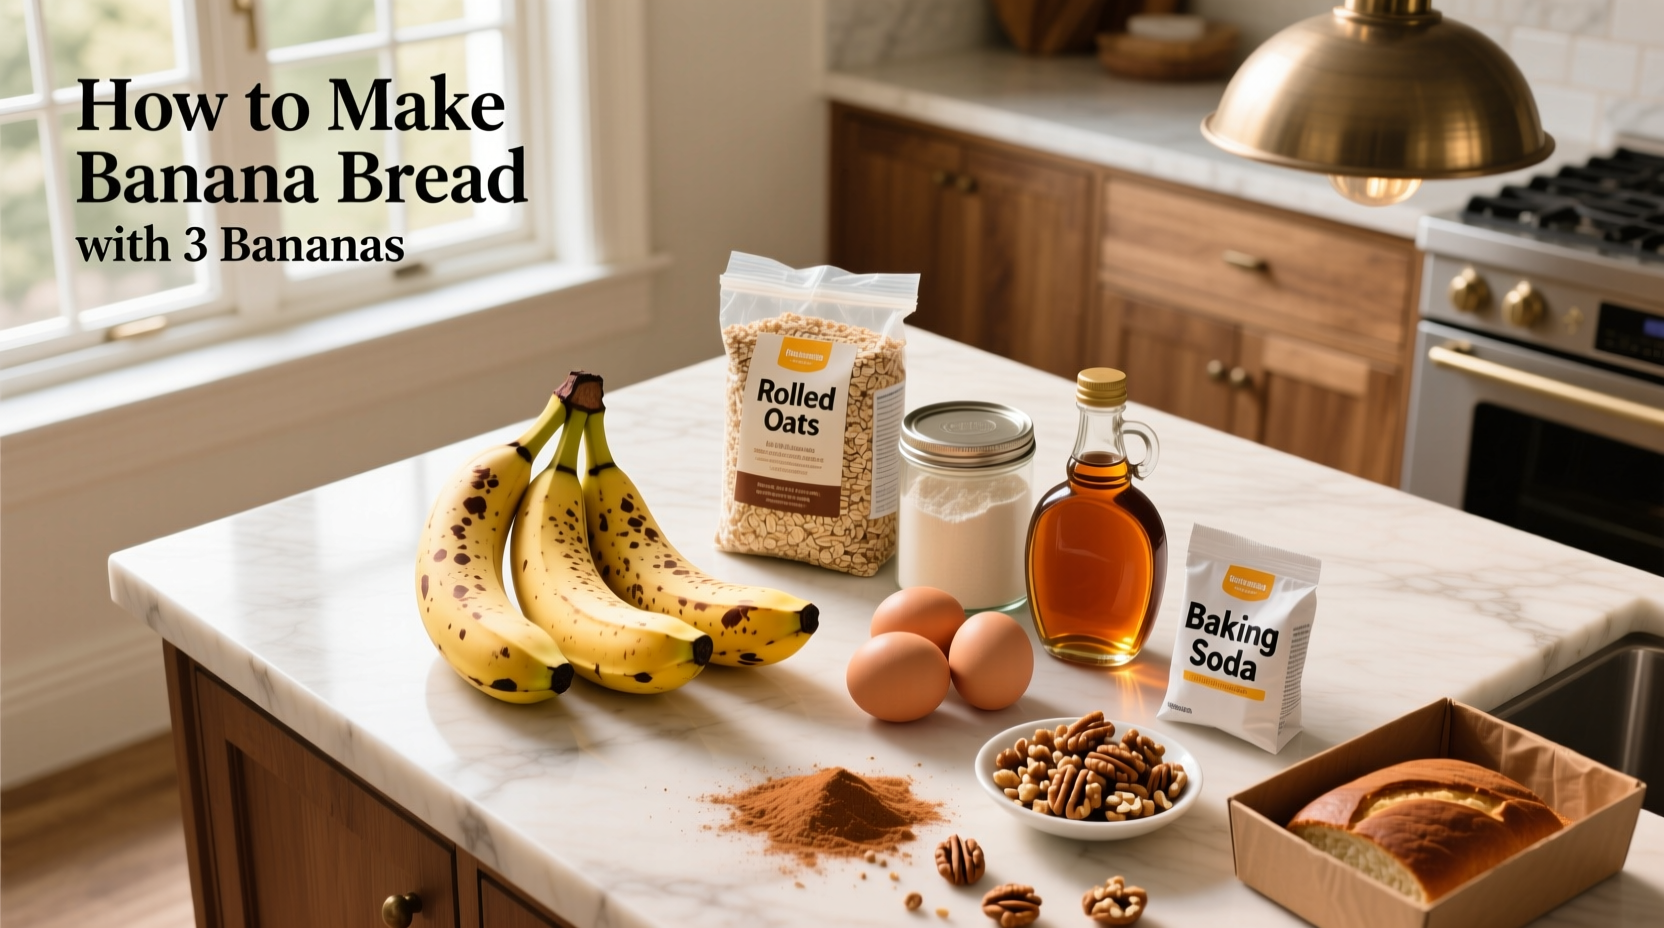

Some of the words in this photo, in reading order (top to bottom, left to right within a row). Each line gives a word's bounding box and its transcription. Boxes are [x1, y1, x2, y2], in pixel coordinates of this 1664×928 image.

[757, 378, 836, 411] Rolled
[764, 407, 819, 436] Oats
[1185, 601, 1279, 657] Baking
[1189, 638, 1257, 682] Soda
